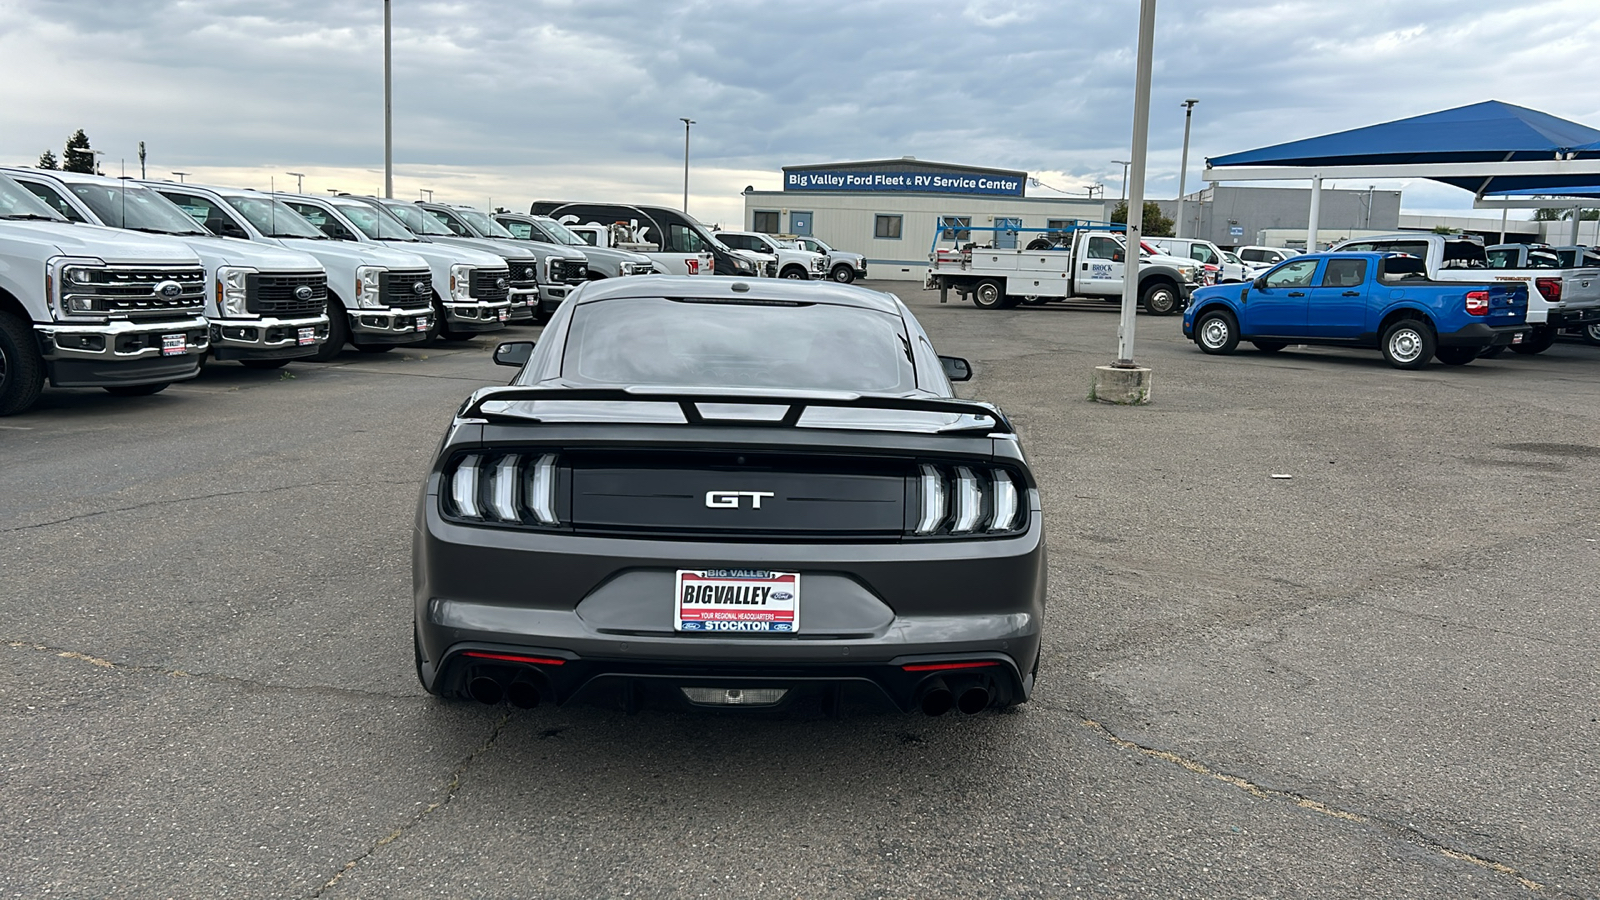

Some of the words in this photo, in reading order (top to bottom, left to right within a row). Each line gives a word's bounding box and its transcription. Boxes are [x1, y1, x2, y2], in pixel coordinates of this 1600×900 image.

[789, 174, 808, 186] Big
[810, 174, 845, 187] Valley
[847, 175, 873, 185] Ford
[875, 175, 904, 185] Fleet
[906, 177, 912, 185] &
[915, 176, 931, 186] RV
[933, 176, 976, 188] Service
[978, 178, 1018, 190] Center
[705, 490, 775, 509] GT
[730, 570, 770, 578] VALLEY
[715, 612, 737, 620] REGIONAL
[705, 621, 770, 631] STOCKTON
